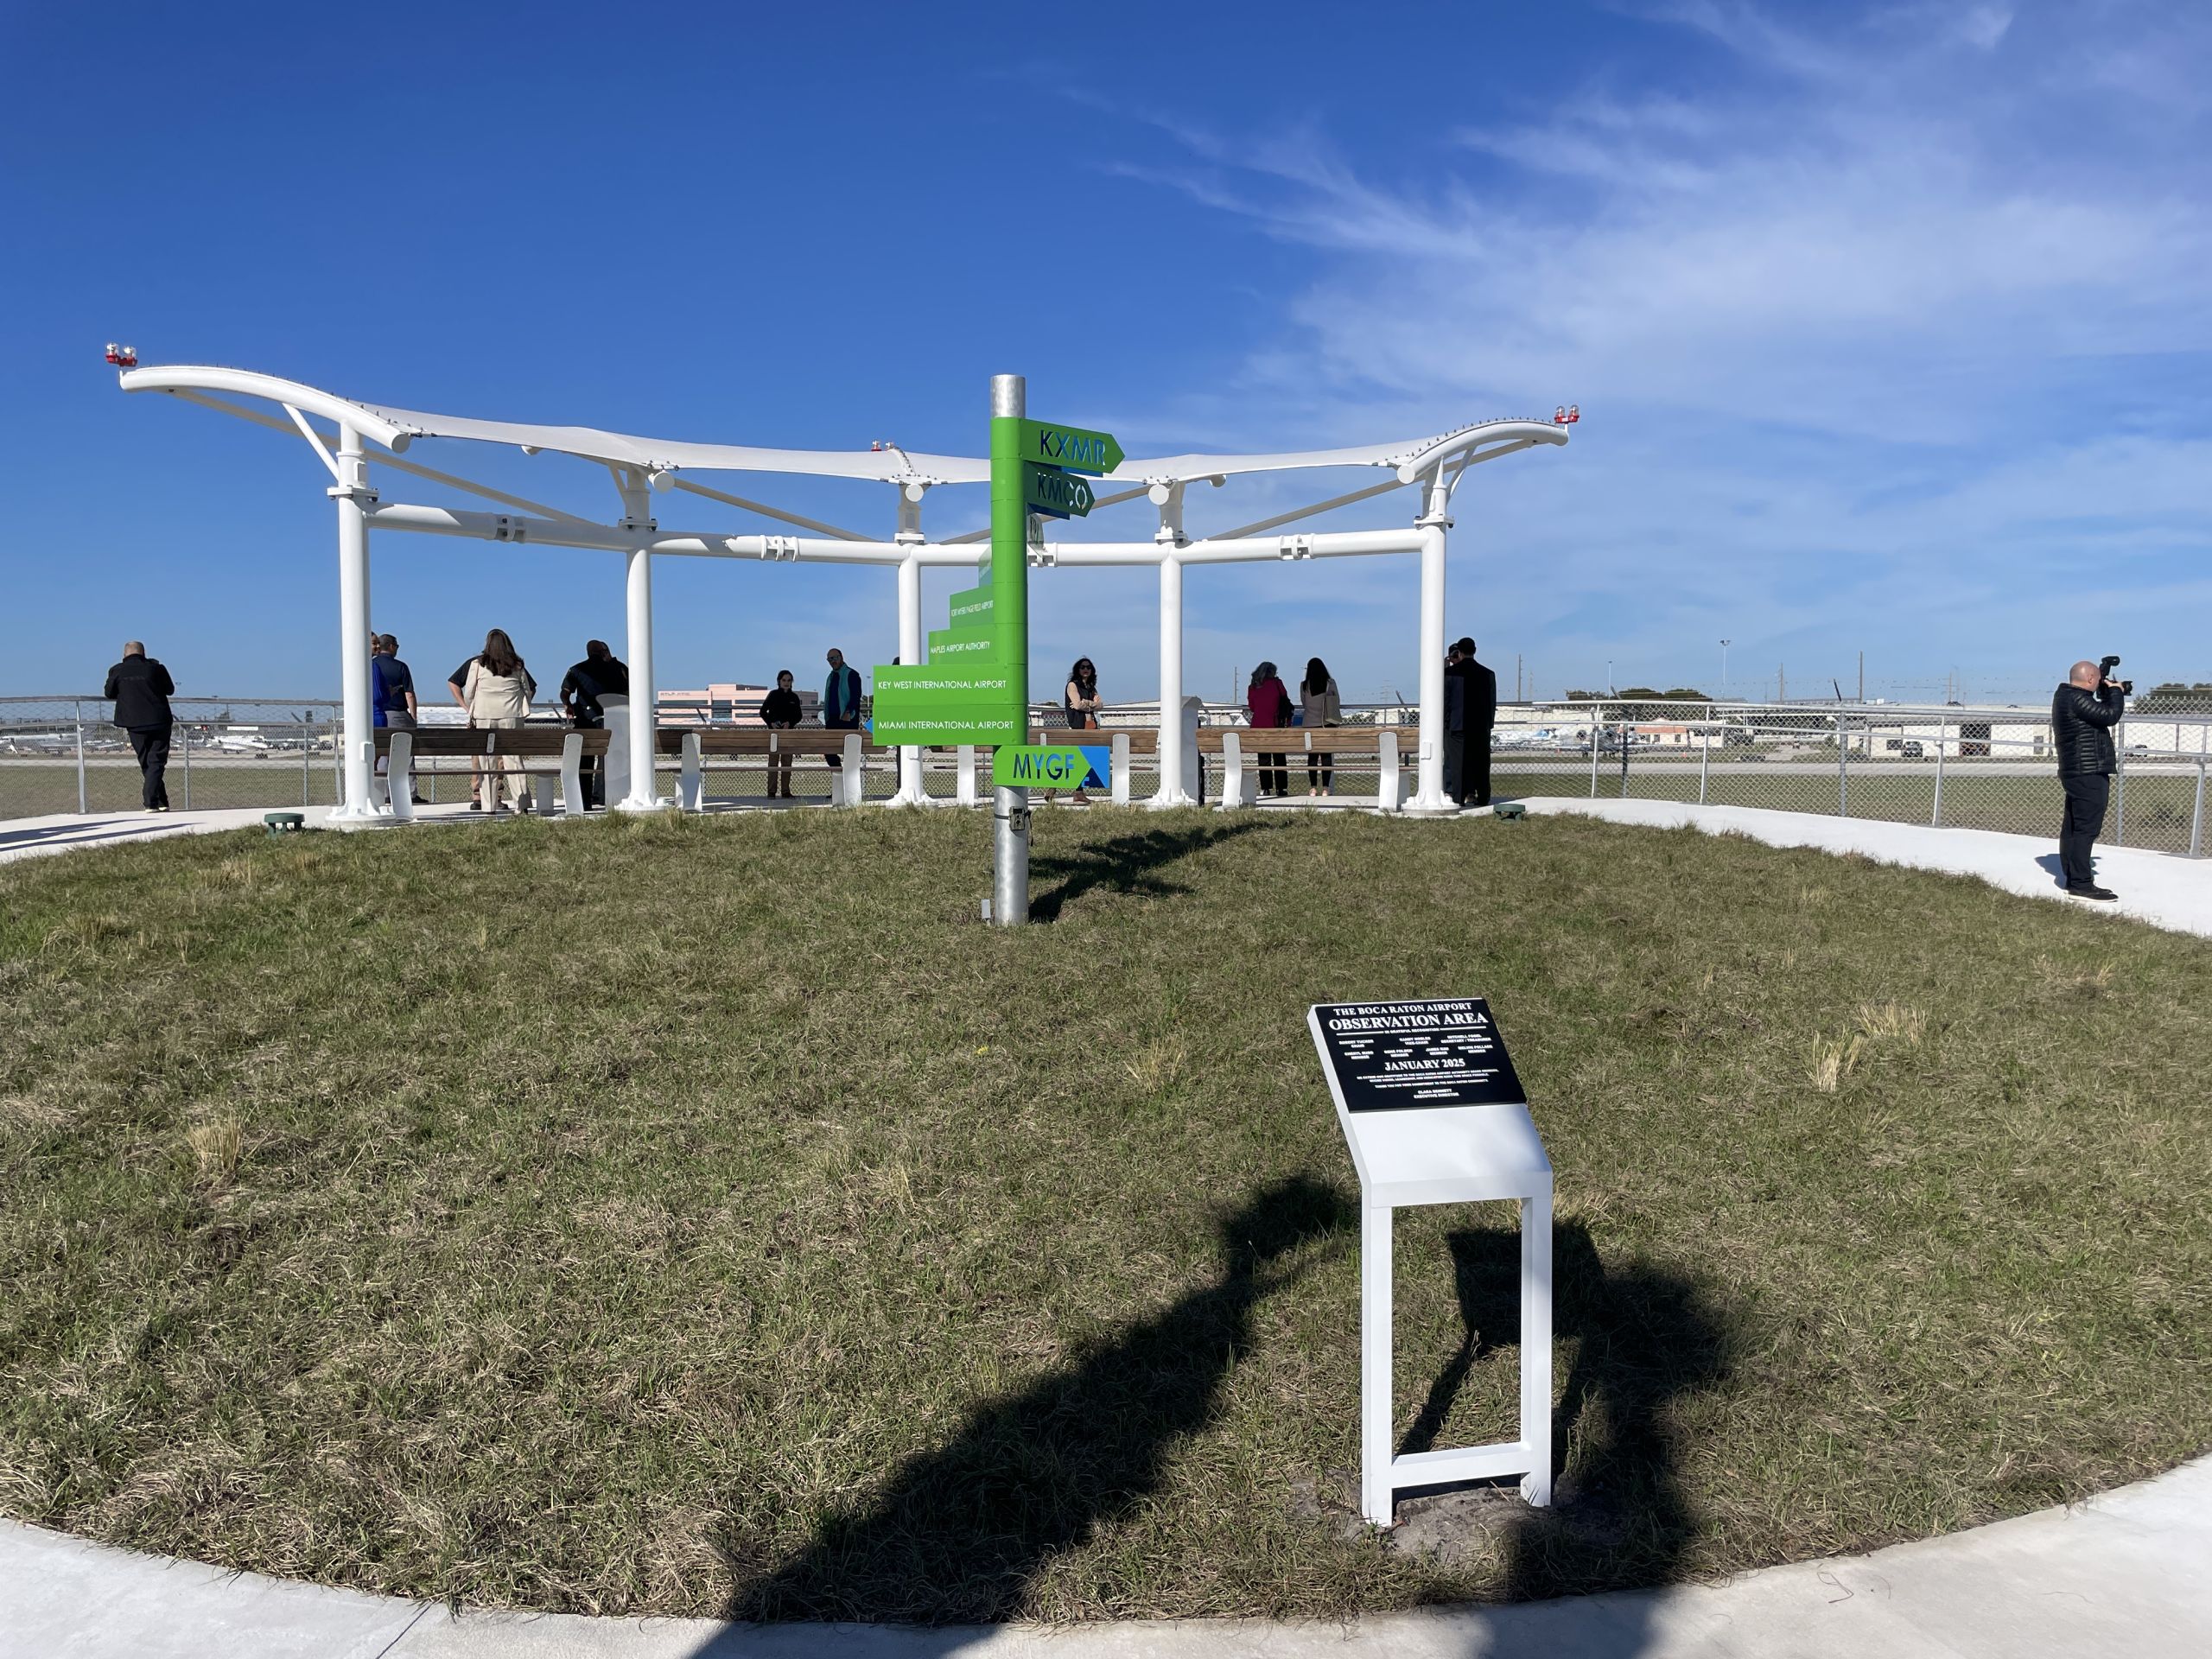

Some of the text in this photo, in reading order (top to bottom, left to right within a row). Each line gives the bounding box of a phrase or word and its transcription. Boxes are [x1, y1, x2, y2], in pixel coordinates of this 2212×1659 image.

[1040, 429, 1105, 466] KXMR
[1038, 473, 1087, 510] KMCO
[931, 641, 990, 654] NAPLES AIRPORT AUTHORITY
[878, 681, 891, 690] KEY
[974, 680, 1006, 689] AIRPORT
[1014, 753, 1075, 780] MYGF
[1333, 1007, 1357, 1016] THE
[1389, 1005, 1425, 1014] RATON
[1427, 1002, 1471, 1012] AIRPORT
[1329, 1013, 1488, 1030] OBSERVATION AREA
[1385, 1058, 1465, 1071] JANUARY 2025
